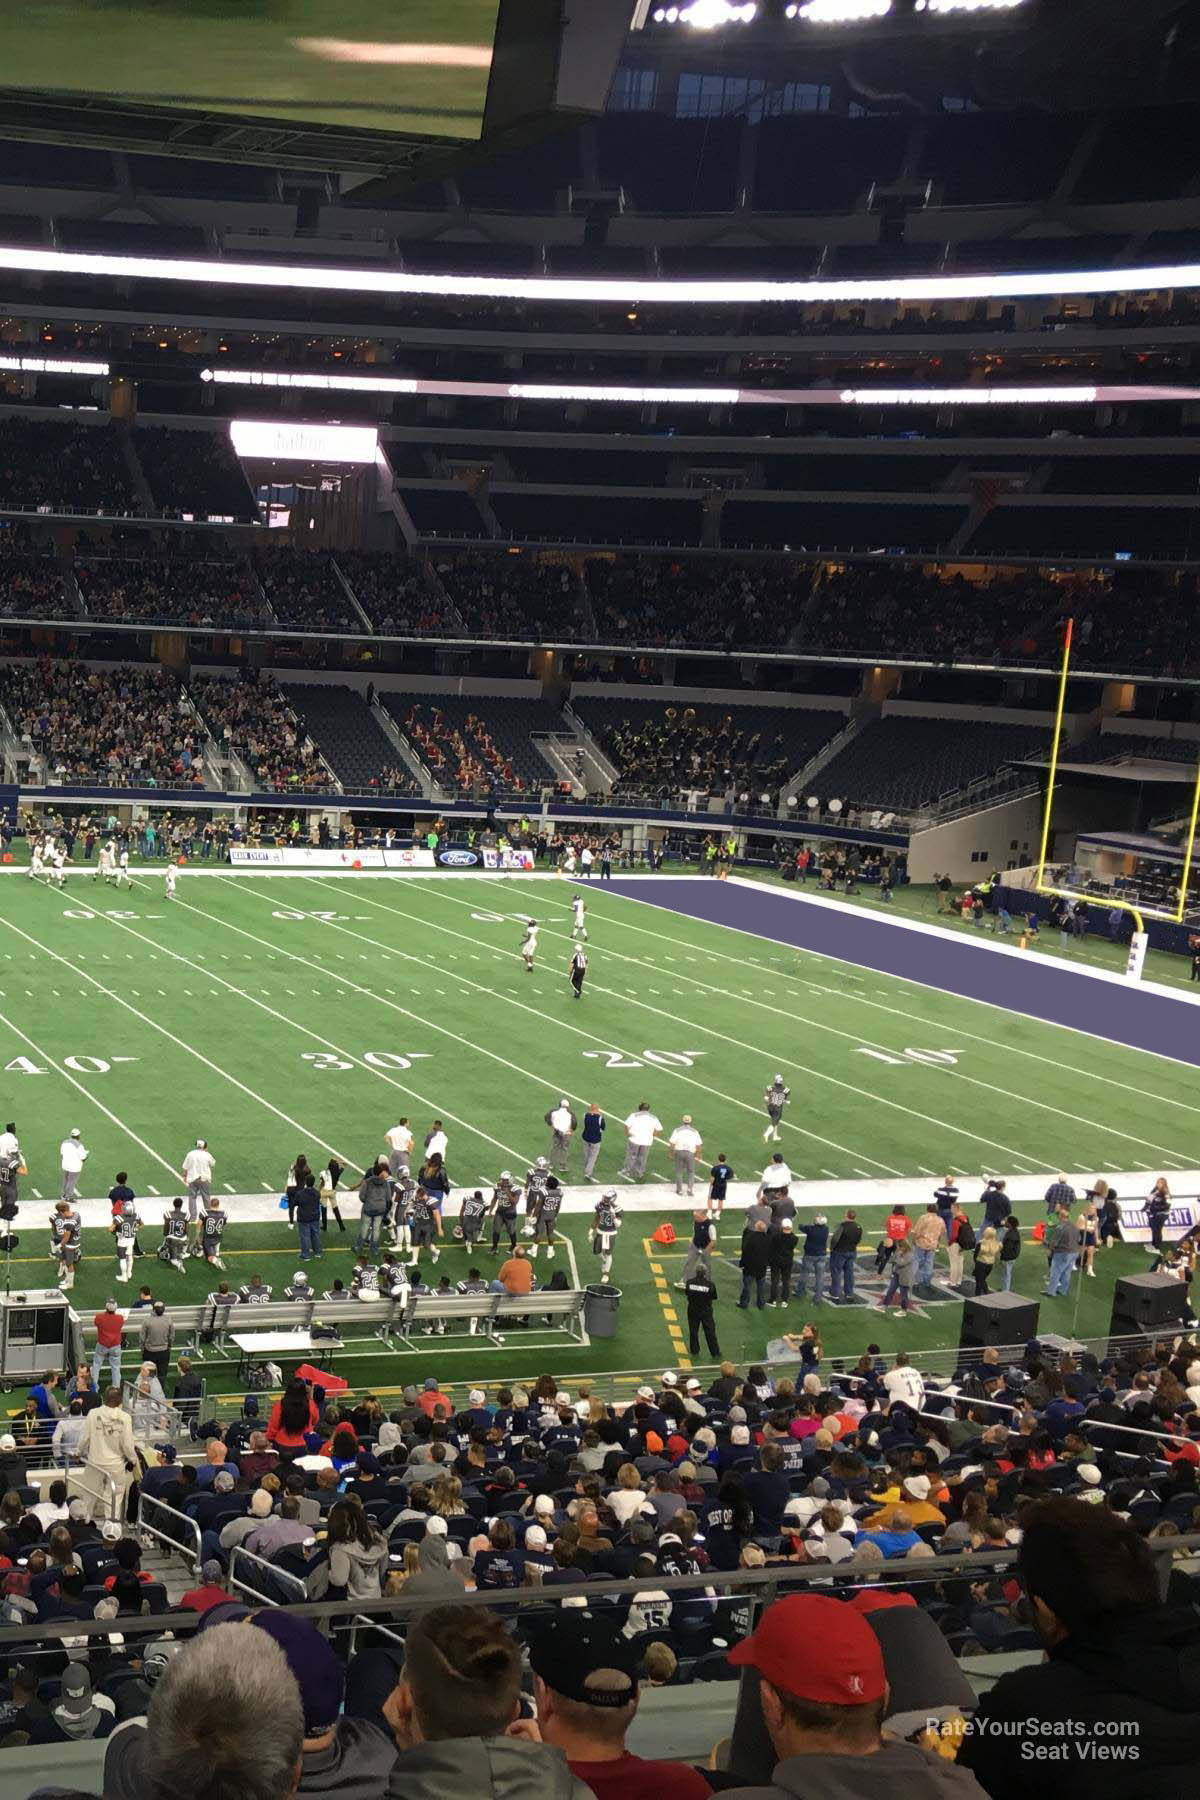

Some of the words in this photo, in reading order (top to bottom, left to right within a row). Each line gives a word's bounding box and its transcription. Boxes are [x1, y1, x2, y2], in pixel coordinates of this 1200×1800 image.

[4, 1055, 112, 1075] 40
[301, 1051, 413, 1071] 30
[581, 1049, 695, 1068] 20
[719, 1167, 727, 1178] 7
[168, 1220, 186, 1236] 13
[205, 1217, 224, 1235] 64
